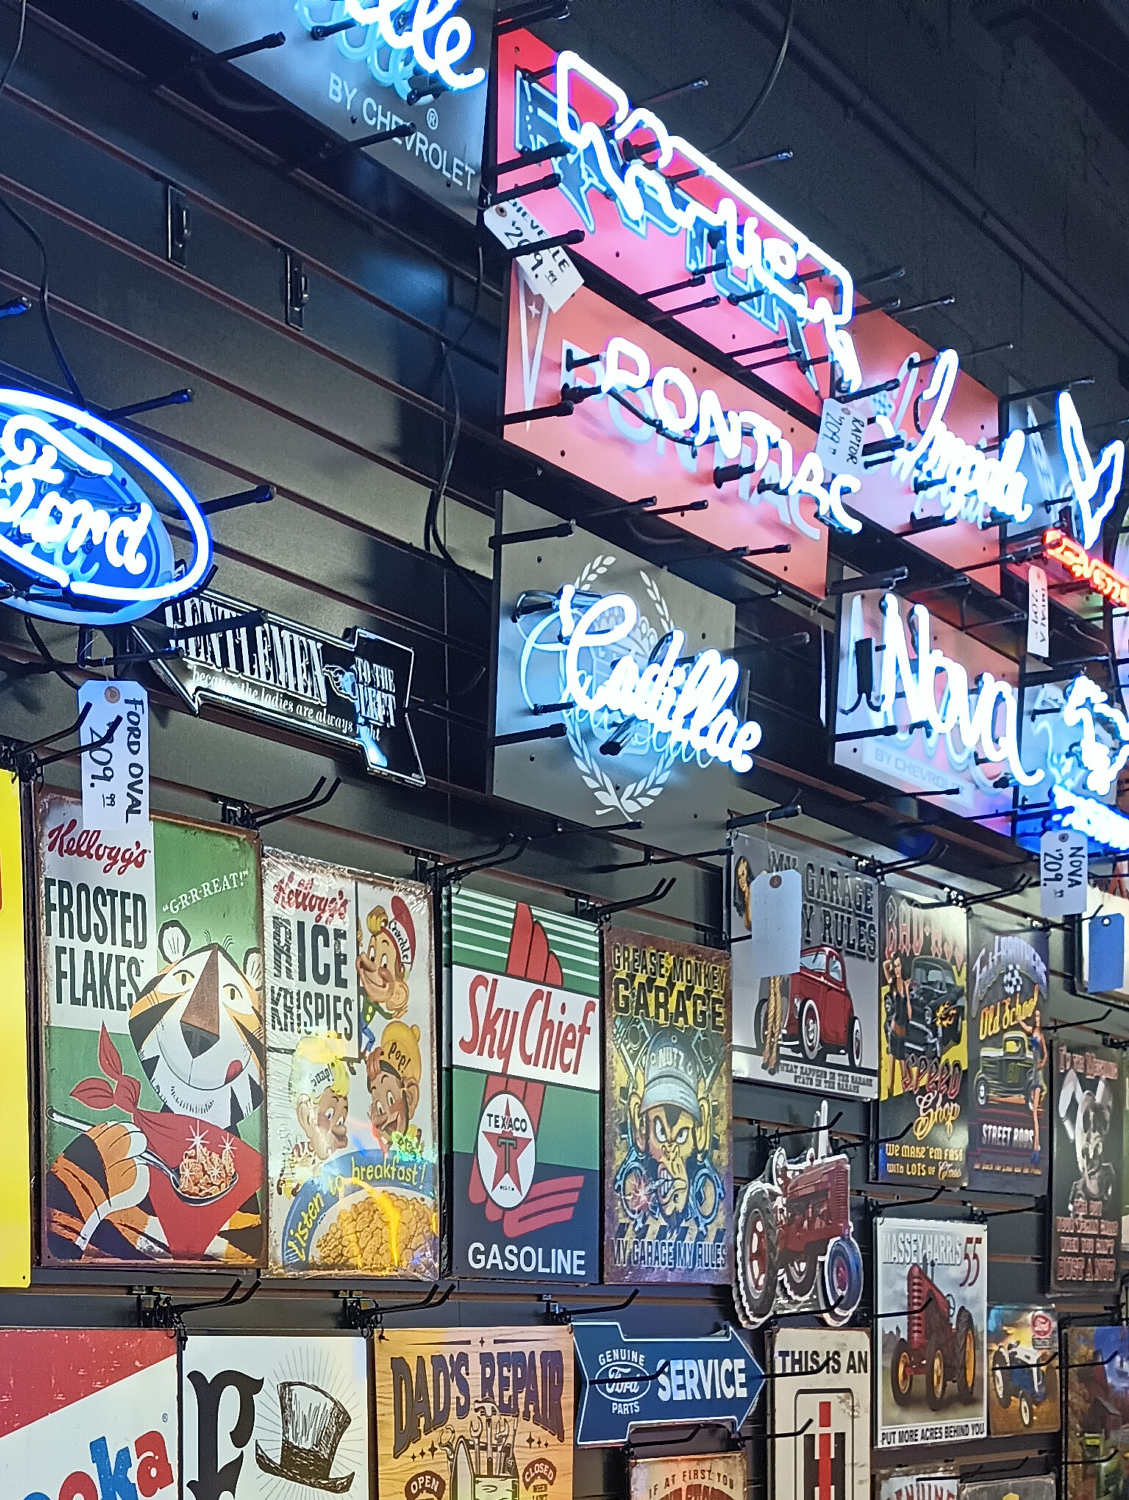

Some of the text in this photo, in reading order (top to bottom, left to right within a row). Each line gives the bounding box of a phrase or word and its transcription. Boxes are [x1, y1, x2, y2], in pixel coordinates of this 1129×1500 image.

[329, 72, 358, 110] BY
[604, 337, 863, 535] PONTIAC
[559, 583, 762, 774] Cadillac
[879, 592, 1045, 787] Nova
[124, 698, 145, 824] FORD OVAL
[47, 818, 148, 876] Kellogg's
[1067, 845, 1084, 889] NOVA
[804, 858, 876, 914] GARAGE
[45, 877, 148, 951] FROSTED
[819, 906, 879, 960] RULES
[54, 944, 143, 1012] FLAKES
[272, 915, 349, 989] RICE
[612, 942, 727, 993] GREASE MONKEY
[270, 984, 355, 1041] KRISPIES
[458, 973, 597, 1079] Sky Chief
[612, 974, 727, 1035] GARAGE
[389, 1040, 411, 1077] Pop!
[485, 1111, 528, 1134] TEXACO
[350, 1153, 427, 1189] breakfast!
[468, 1241, 587, 1277] GASOLINE
[881, 1231, 962, 1267] MASSEY-HARRIS
[959, 1236, 983, 1288] 55
[598, 1348, 646, 1367] GENUINE
[657, 1358, 748, 1402] SERVICE
[777, 1350, 869, 1375] THIS IS AN
[390, 1349, 566, 1460] DAD'S REPAIR
[611, 1400, 641, 1415] PARTS
[410, 1475, 440, 1495] OPEN
[524, 1462, 556, 1483] CLOSED
